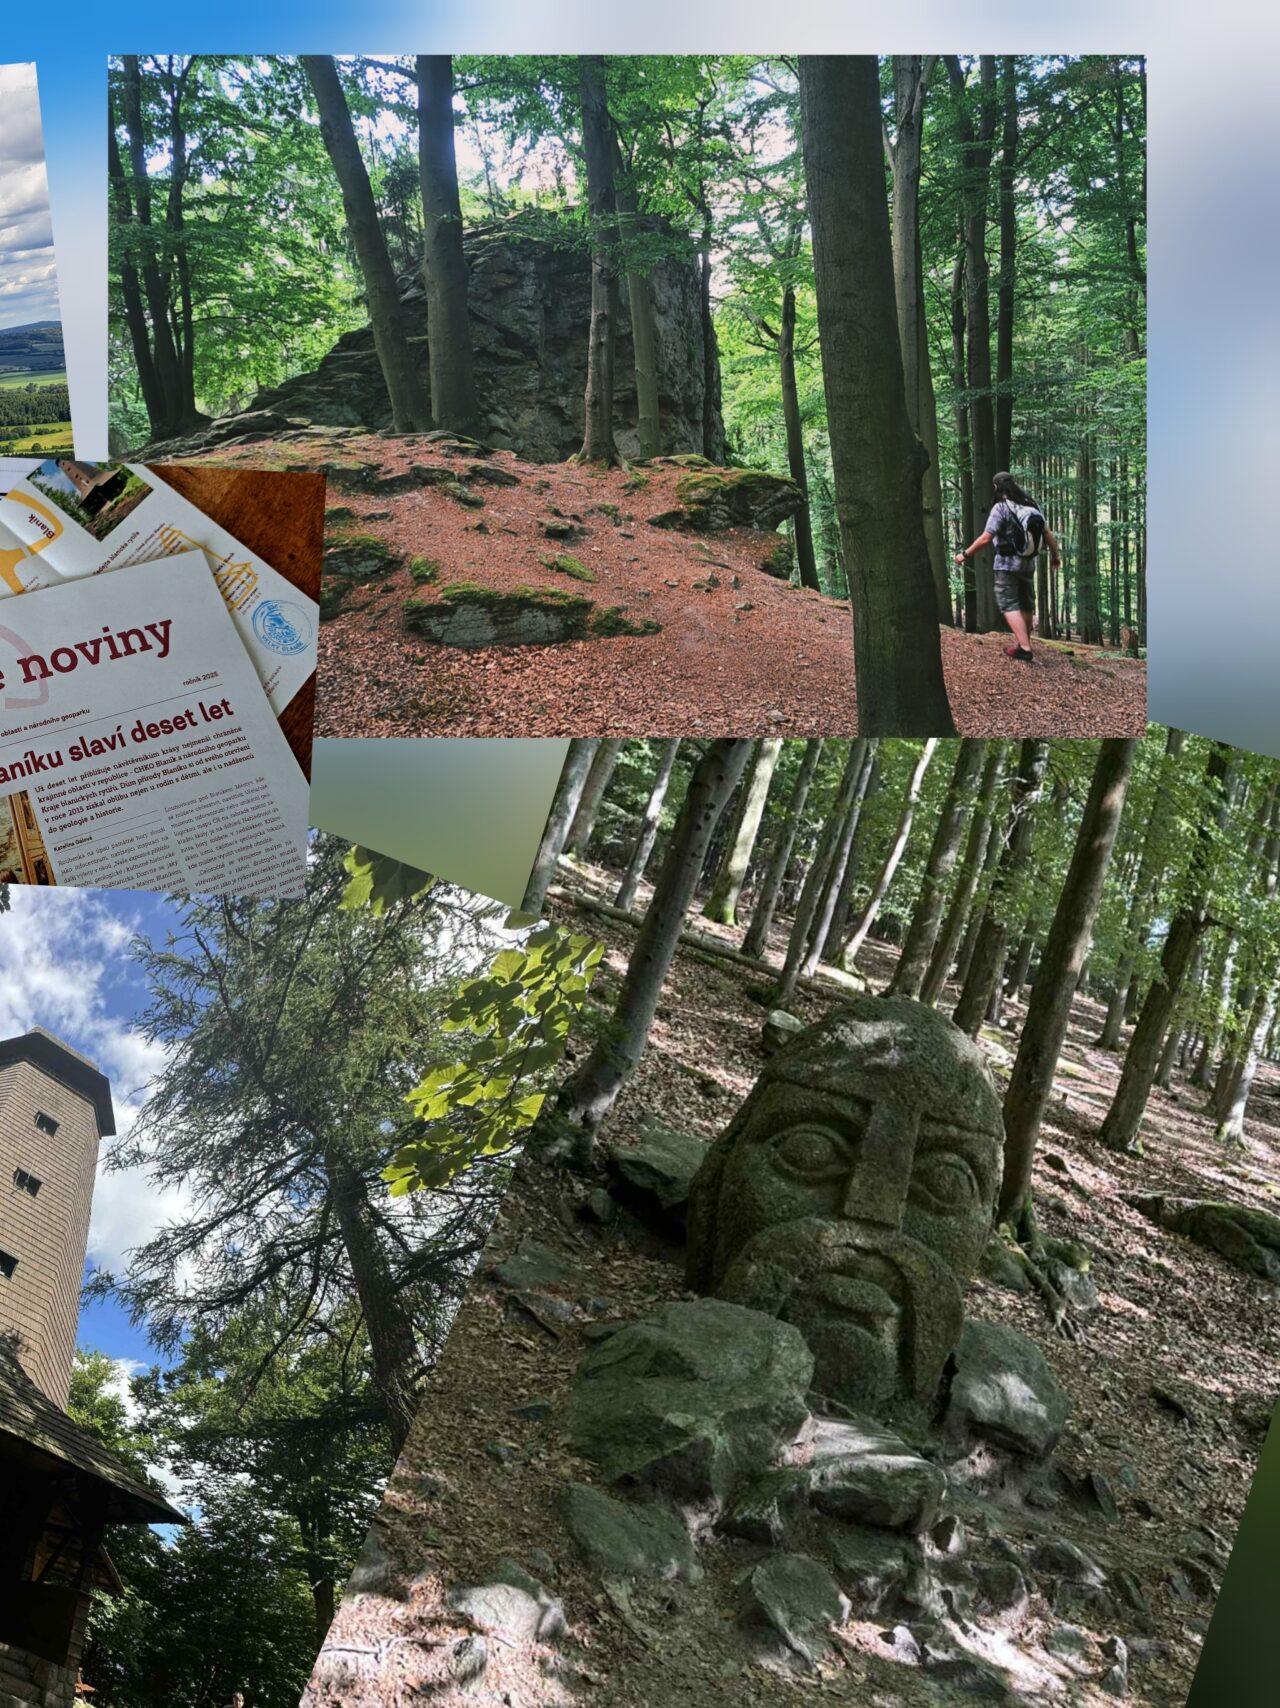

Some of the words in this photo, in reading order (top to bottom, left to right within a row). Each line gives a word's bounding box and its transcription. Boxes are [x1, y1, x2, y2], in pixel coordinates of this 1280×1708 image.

[28, 513, 55, 540] Blaník
[16, 619, 173, 684] noviny
[0, 727, 23, 737] oblasti
[28, 717, 60, 730] národního
[60, 709, 90, 722] geoparku
[68, 725, 127, 762] slaví
[130, 708, 198, 743] deset
[198, 698, 234, 723] let
[37, 789, 67, 804] krajinné
[67, 782, 91, 794] oblasti
[97, 772, 129, 785] republice
[133, 762, 155, 774] CHKO
[155, 756, 178, 768] Blaník
[182, 745, 216, 759] národního
[216, 736, 247, 750] geoparku
[41, 803, 60, 814] Kraje
[60, 791, 98, 807] blanických
[119, 780, 137, 789] Dům
[137, 772, 161, 786] přírody
[161, 764, 188, 776] Blaníku
[194, 758, 204, 766] od
[204, 753, 224, 763] svého
[224, 743, 251, 757] otevření
[47, 779, 66, 790] deset
[67, 775, 78, 783] let
[79, 766, 111, 782] přibližuje
[113, 752, 160, 770] návštěvníkům
[160, 745, 180, 755] krásy
[212, 727, 242, 739] chráněné
[51, 813, 67, 822] roce
[67, 806, 85, 816] 2015
[85, 799, 106, 811] získal
[107, 793, 129, 804] oblibu
[129, 787, 149, 797] nejen
[156, 779, 175, 789] rodin
[180, 771, 202, 781] dětmi,
[223, 753, 255, 768] nadšenců
[48, 826, 58, 834] do
[58, 817, 88, 832] geologie
[94, 806, 124, 819] historie.
